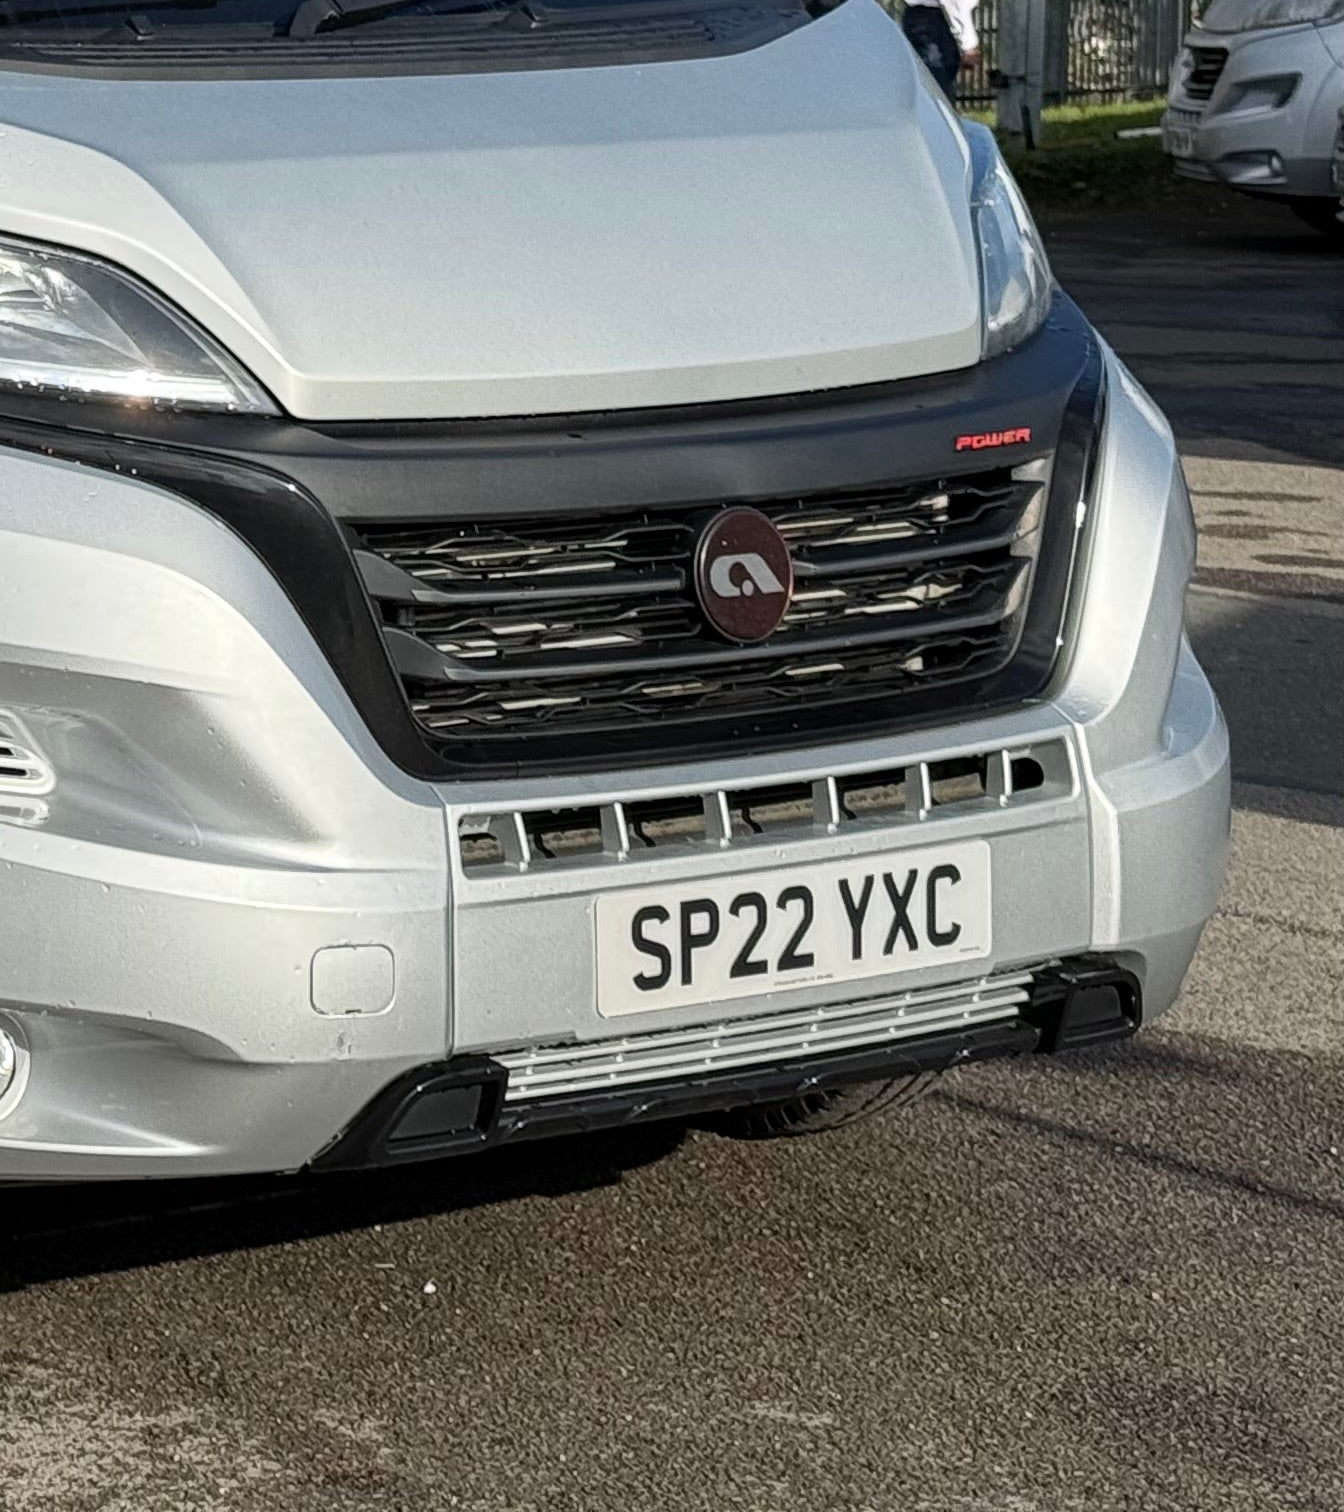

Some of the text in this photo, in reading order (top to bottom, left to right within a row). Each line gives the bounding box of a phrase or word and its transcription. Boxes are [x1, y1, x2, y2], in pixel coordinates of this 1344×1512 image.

[955, 427, 1031, 451] POWER
[631, 863, 962, 992] SP22 YXC
